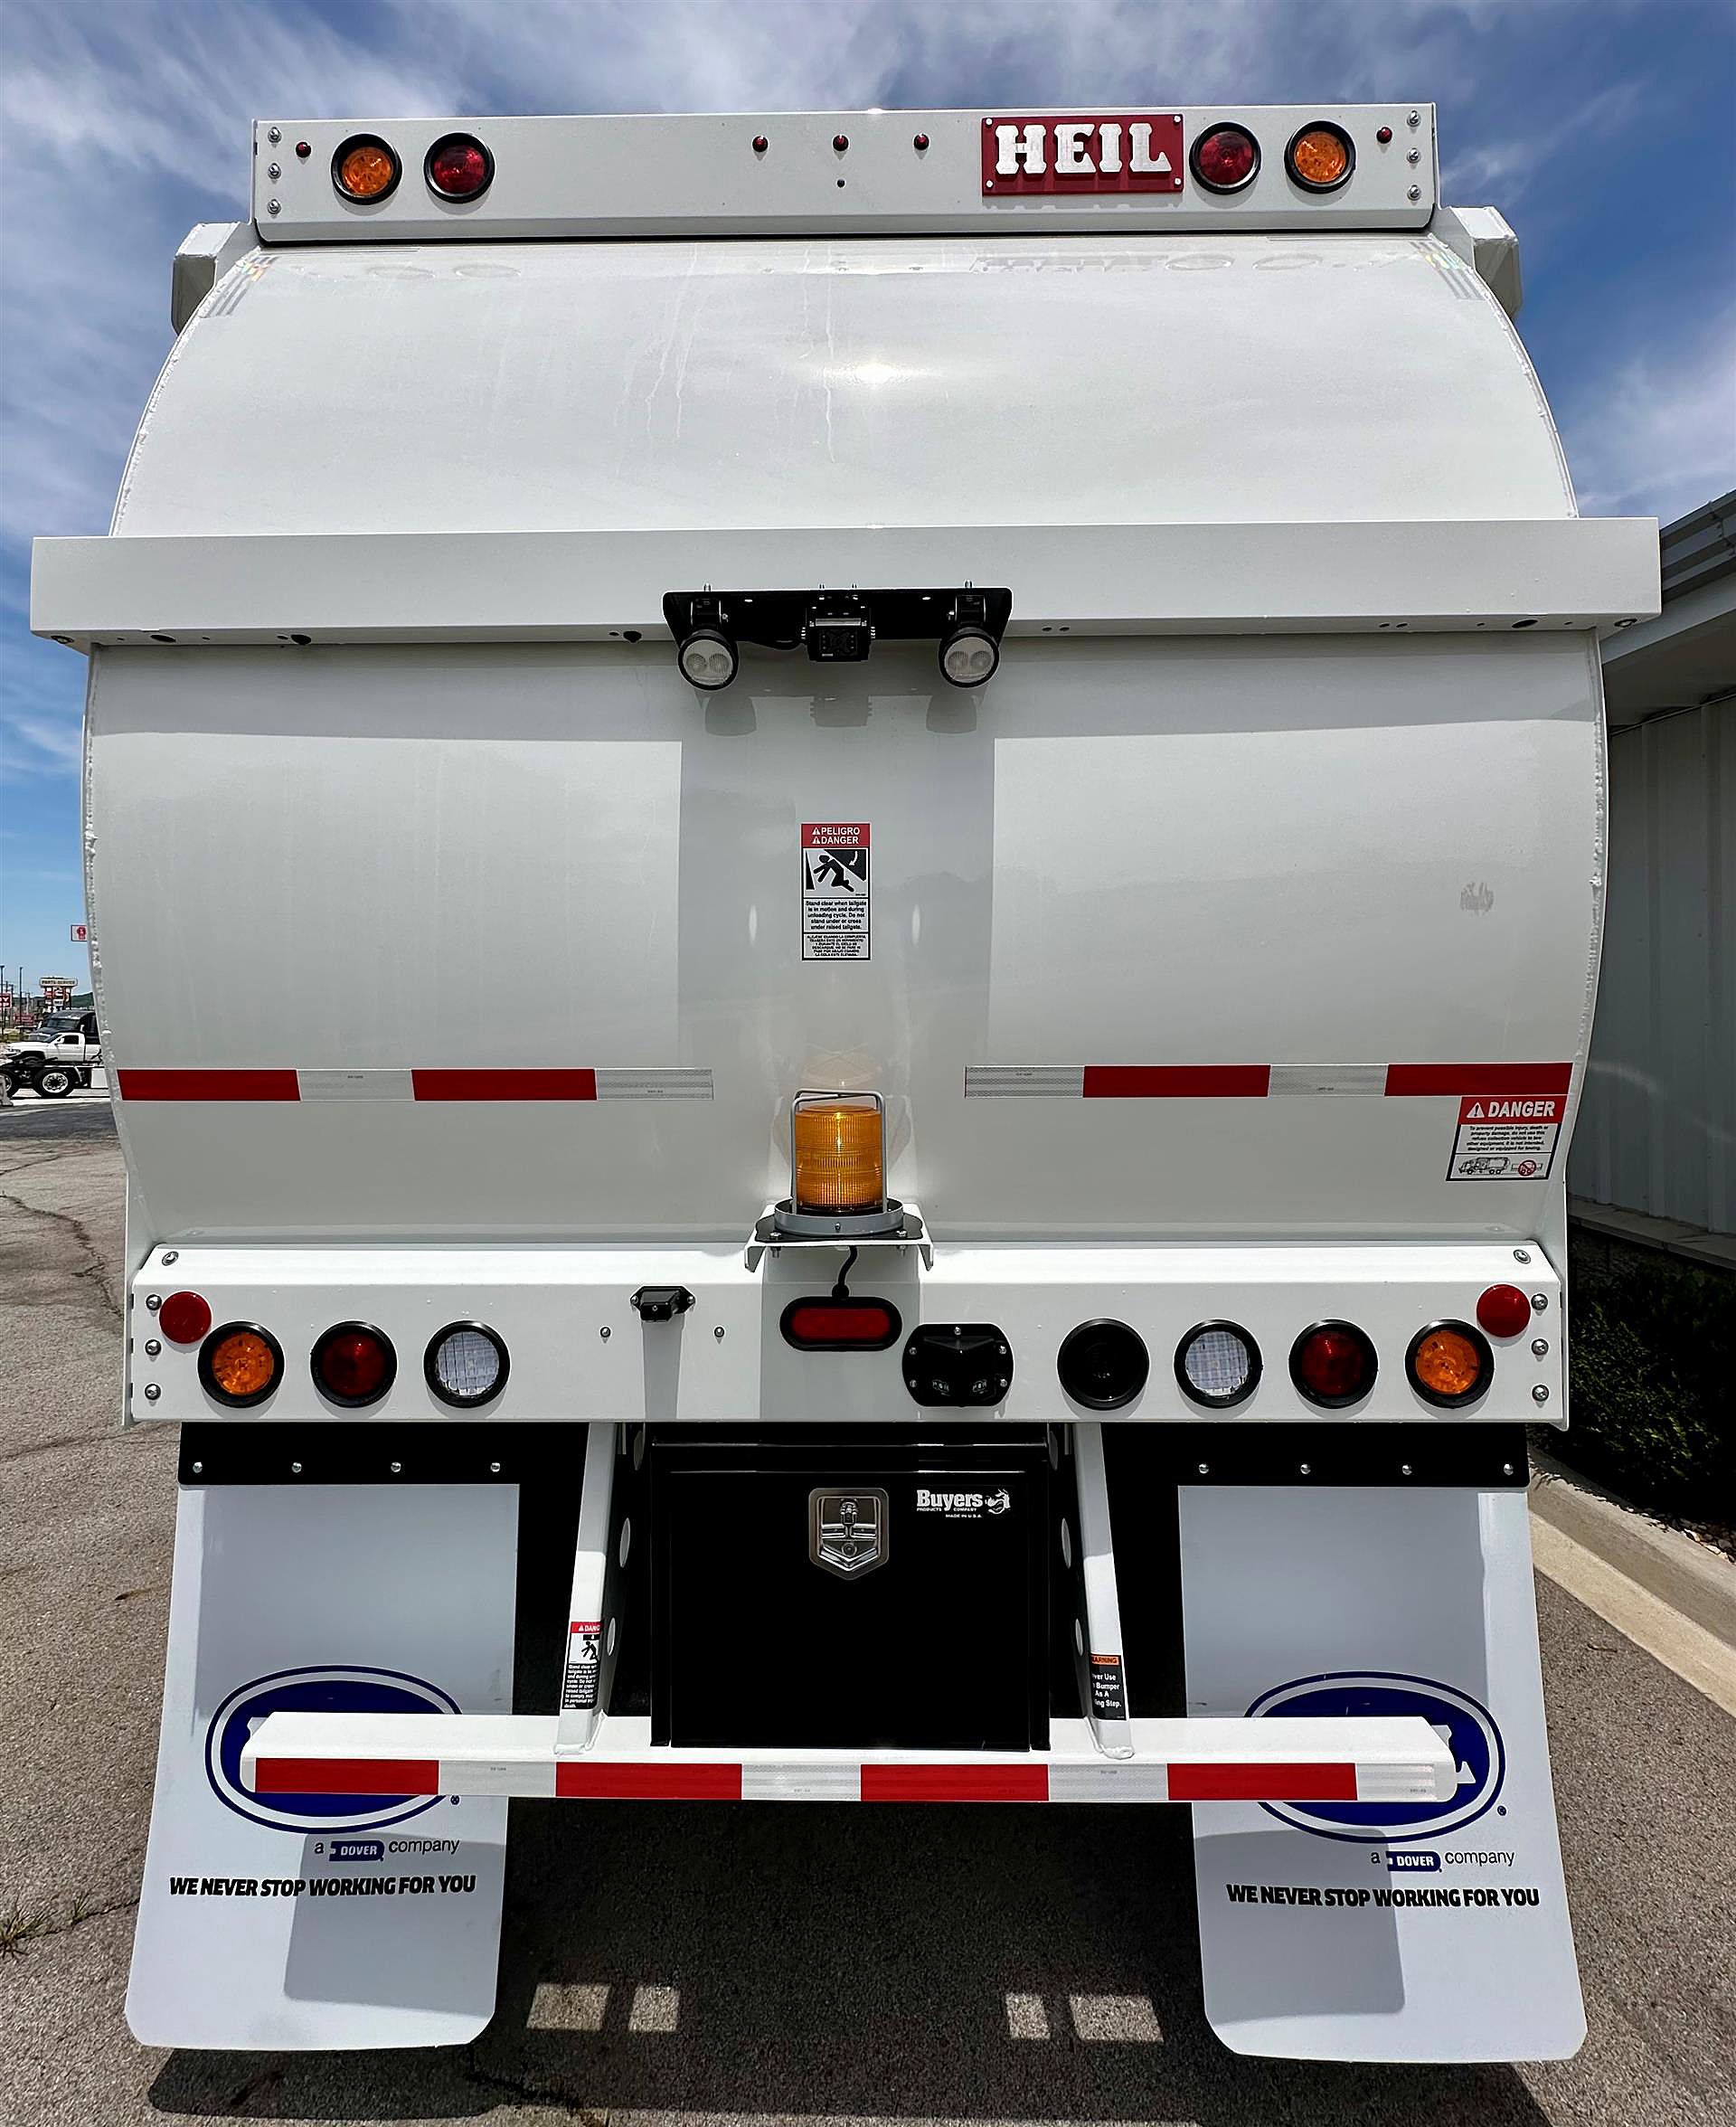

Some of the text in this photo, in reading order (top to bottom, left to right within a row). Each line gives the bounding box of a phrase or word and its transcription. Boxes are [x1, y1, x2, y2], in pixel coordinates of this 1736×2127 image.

[995, 123, 1172, 174] HEIL
[821, 827, 860, 835] PELIGRO
[821, 836, 859, 844] DANGER
[1488, 1101, 1555, 1117] DANGER
[917, 1489, 983, 1511] Buyers
[1096, 1682, 1120, 1691] Bumper
[1106, 1700, 1121, 1708] Step.
[314, 1839, 460, 1856] a DOVER company
[1371, 1851, 1514, 1867] a DOVER company
[170, 1875, 476, 1896] WE NEVER STOP WORKING FOR YOU
[1226, 1884, 1540, 1907] WE NEVER STOP WORKING FOR YOU
